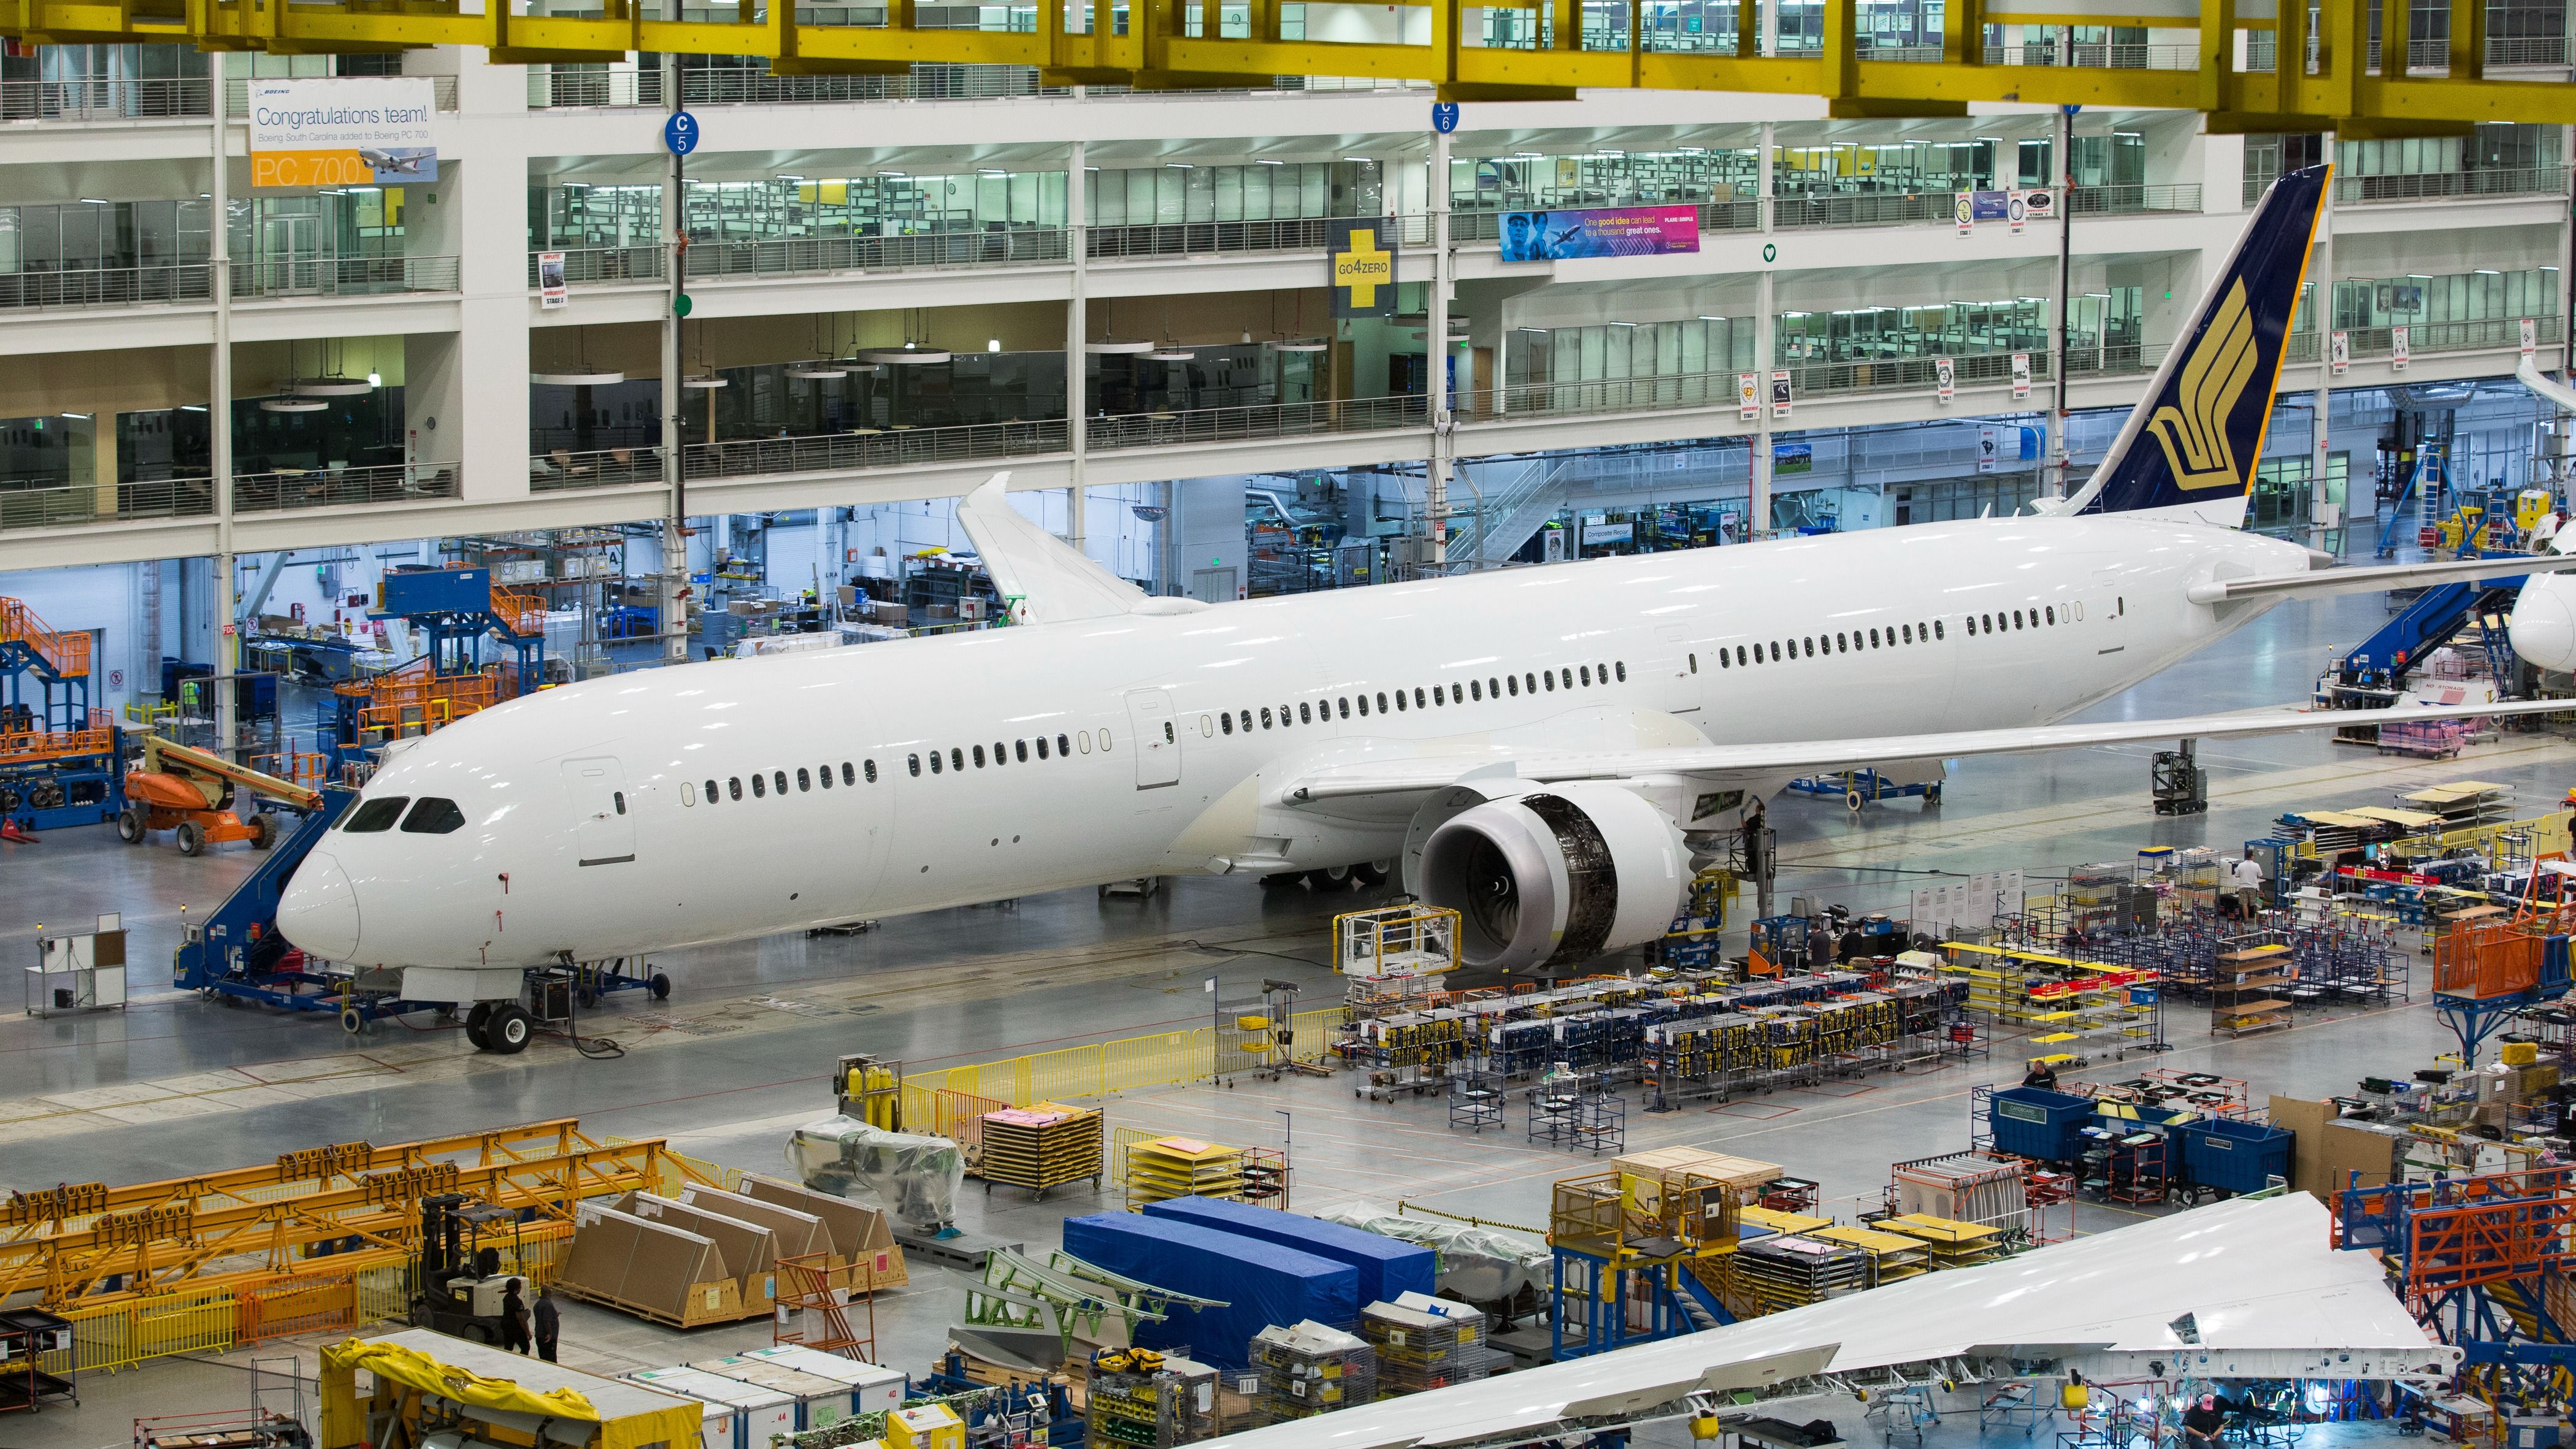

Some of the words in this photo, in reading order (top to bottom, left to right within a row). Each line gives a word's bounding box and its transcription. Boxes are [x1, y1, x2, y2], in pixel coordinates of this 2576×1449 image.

[257, 106, 380, 129] Congratulations
[385, 105, 427, 123] team!
[677, 116, 688, 131] C
[1443, 117, 1449, 129] 6
[258, 133, 283, 143] Boeing
[286, 132, 307, 142] South
[309, 132, 337, 141] Carolina
[340, 131, 362, 140] added
[365, 131, 372, 140] to
[374, 130, 399, 141] Boeing
[401, 130, 412, 139] PC
[415, 130, 428, 139] 700
[678, 136, 686, 151] 5
[256, 157, 297, 186] PC
[309, 156, 359, 185] 700
[1585, 218, 1597, 227] One
[1598, 218, 1614, 227] good
[1616, 216, 1630, 225] idea
[1643, 215, 1655, 224] lead
[1598, 227, 1625, 237] thousand
[1626, 227, 1643, 236] great
[1339, 259, 1387, 275] GO4ZERO
[2010, 1106, 2035, 1114] CARDBOARD
